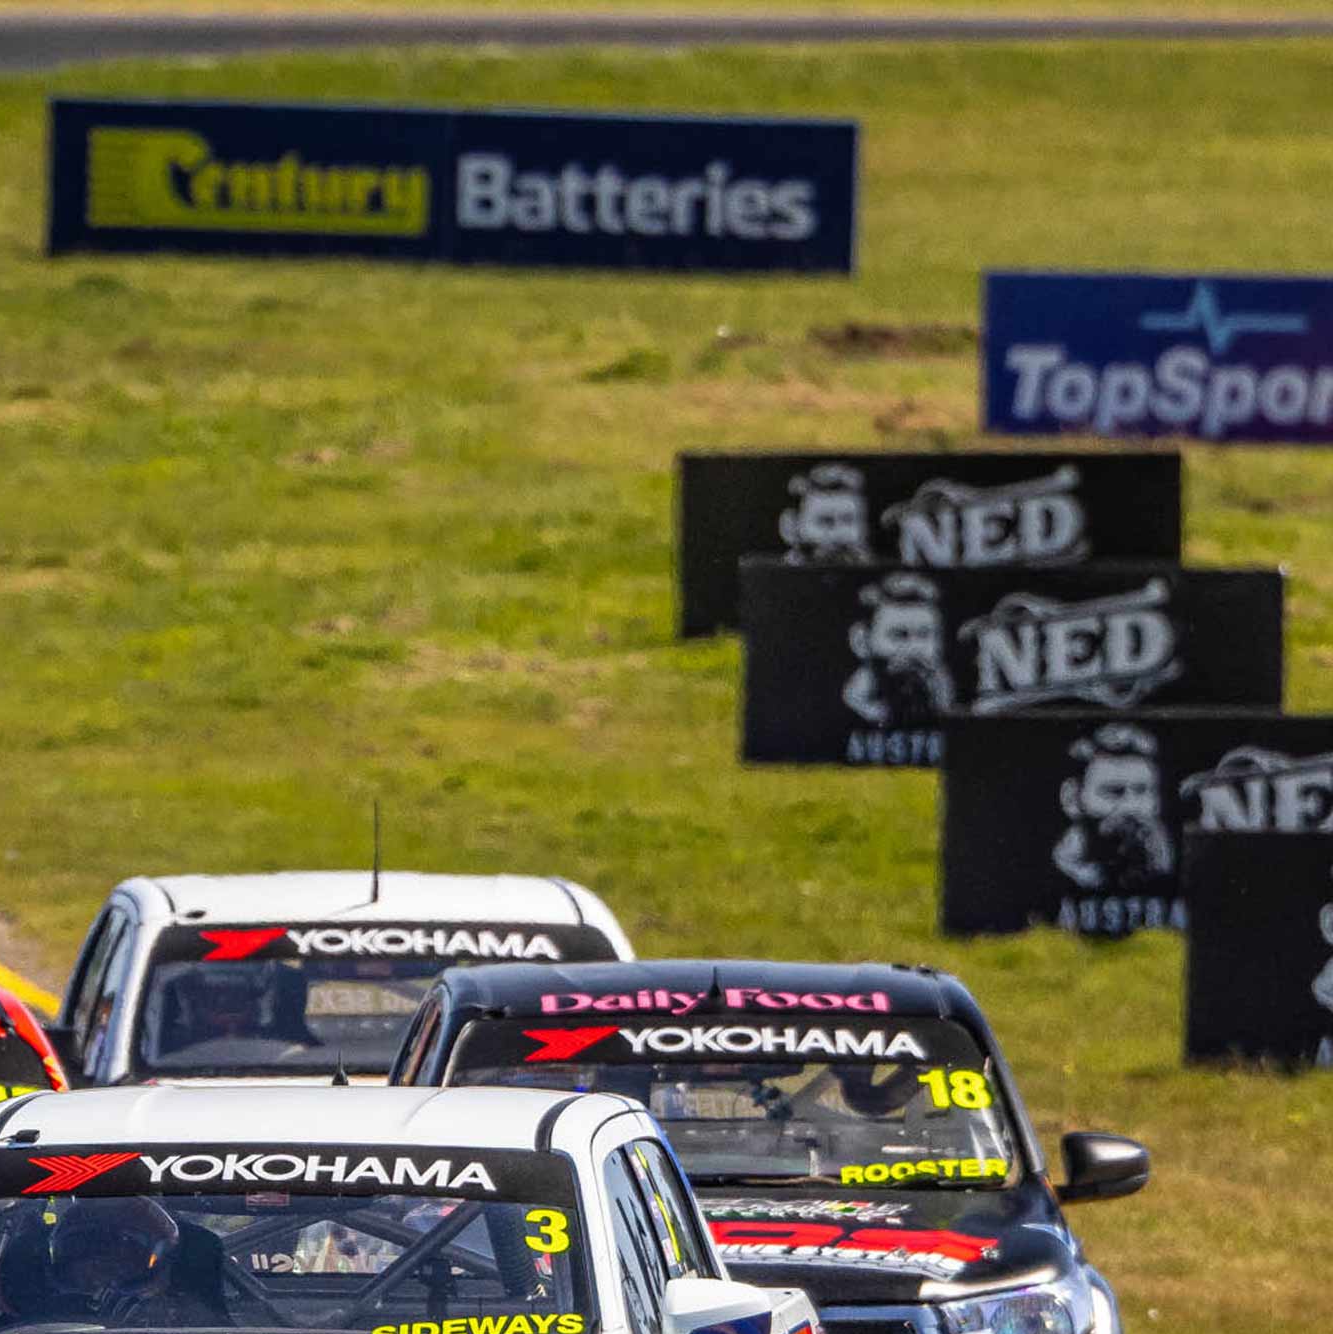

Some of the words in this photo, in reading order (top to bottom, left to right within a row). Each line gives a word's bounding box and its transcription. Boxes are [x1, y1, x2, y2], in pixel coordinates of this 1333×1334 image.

[88, 126, 428, 235] Century
[458, 154, 815, 240] Batteries
[1004, 343, 1333, 437] TopSpor
[895, 496, 1086, 566] NED
[973, 609, 1177, 694] NED
[287, 928, 560, 960] YOKOHAMA
[541, 987, 713, 1015] Daily
[726, 988, 889, 1012] Food
[620, 1026, 925, 1059] YOKOHAMA
[919, 1067, 992, 1109] 18
[139, 1153, 496, 1192] YOKOHAMA
[840, 1158, 1007, 1186] ROOSTER
[525, 1210, 569, 1253] 3
